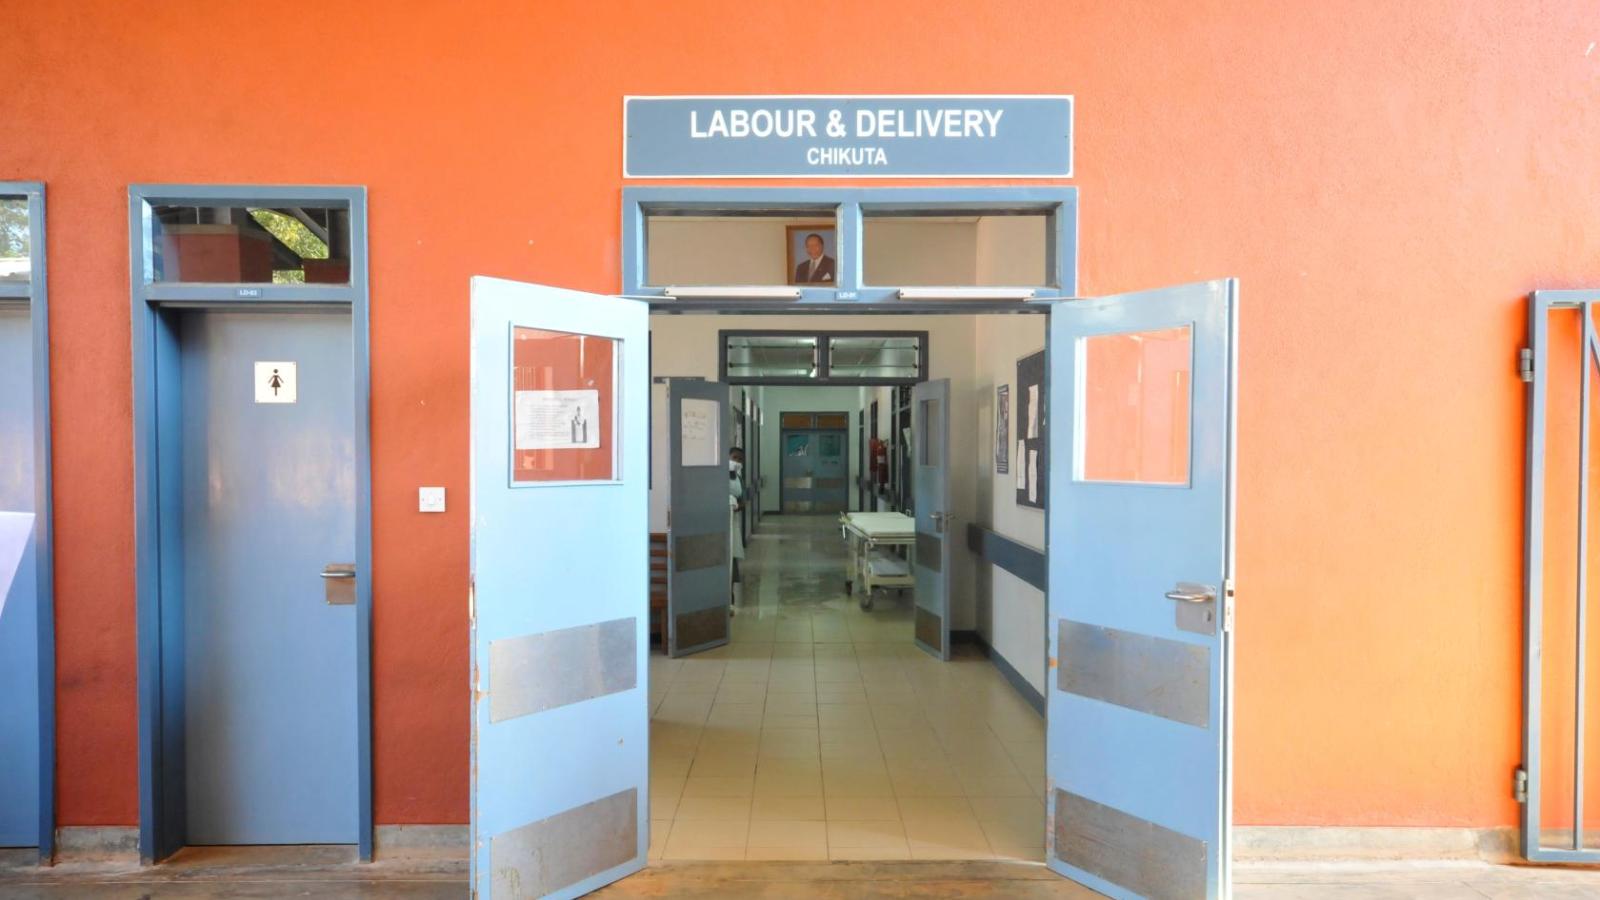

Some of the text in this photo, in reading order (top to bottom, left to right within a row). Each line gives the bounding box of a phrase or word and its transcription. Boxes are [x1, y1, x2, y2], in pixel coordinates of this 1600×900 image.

[690, 109, 1003, 138] LABOUR & DELIVERY
[806, 147, 888, 165] CHIKUTA
